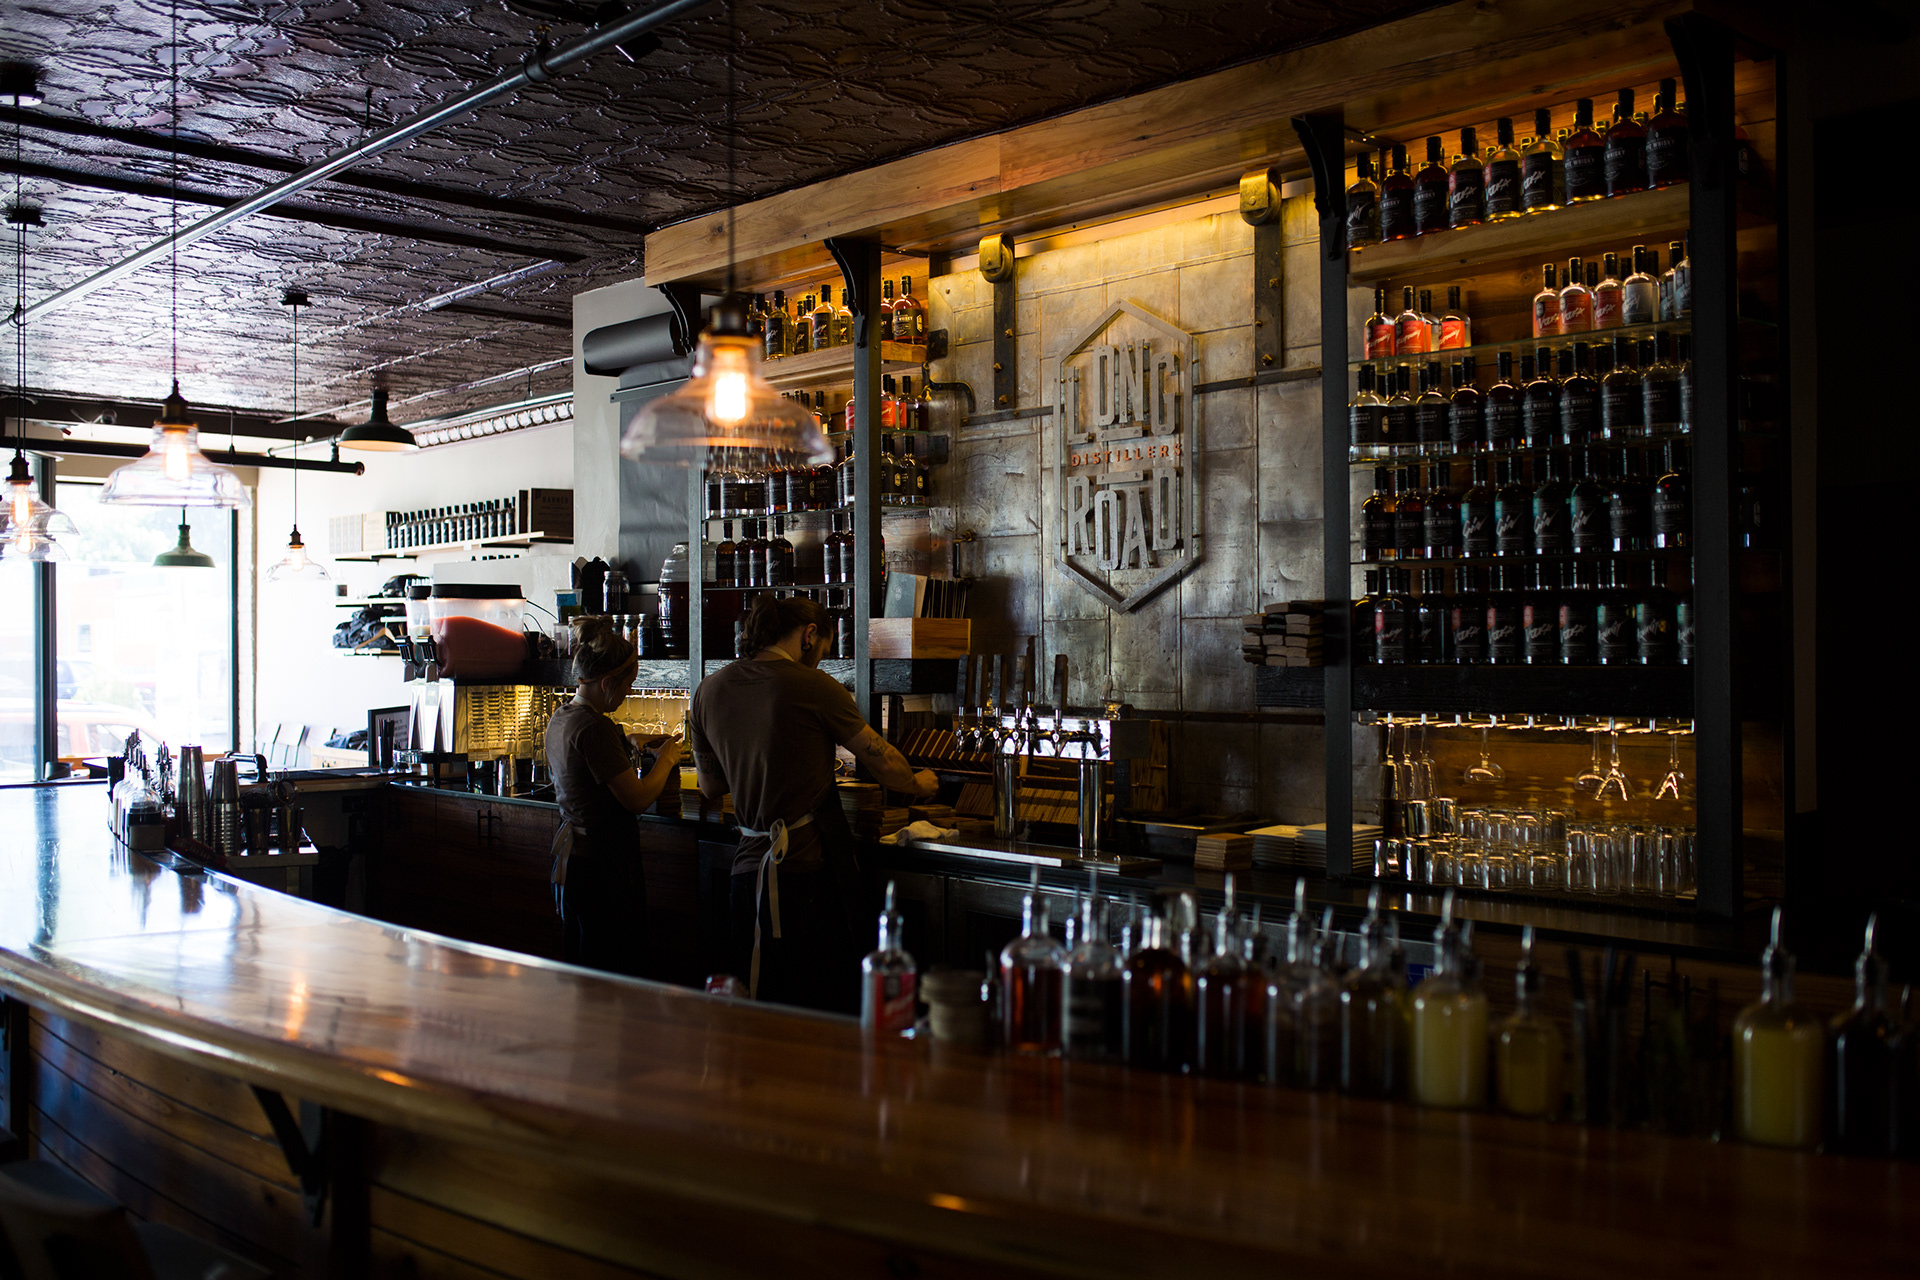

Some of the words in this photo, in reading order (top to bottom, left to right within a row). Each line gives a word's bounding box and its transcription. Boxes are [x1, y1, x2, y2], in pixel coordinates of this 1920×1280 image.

[1067, 338, 1176, 445] LONG
[1071, 443, 1182, 468] DISTILLERS
[1067, 466, 1177, 571] ROAD
